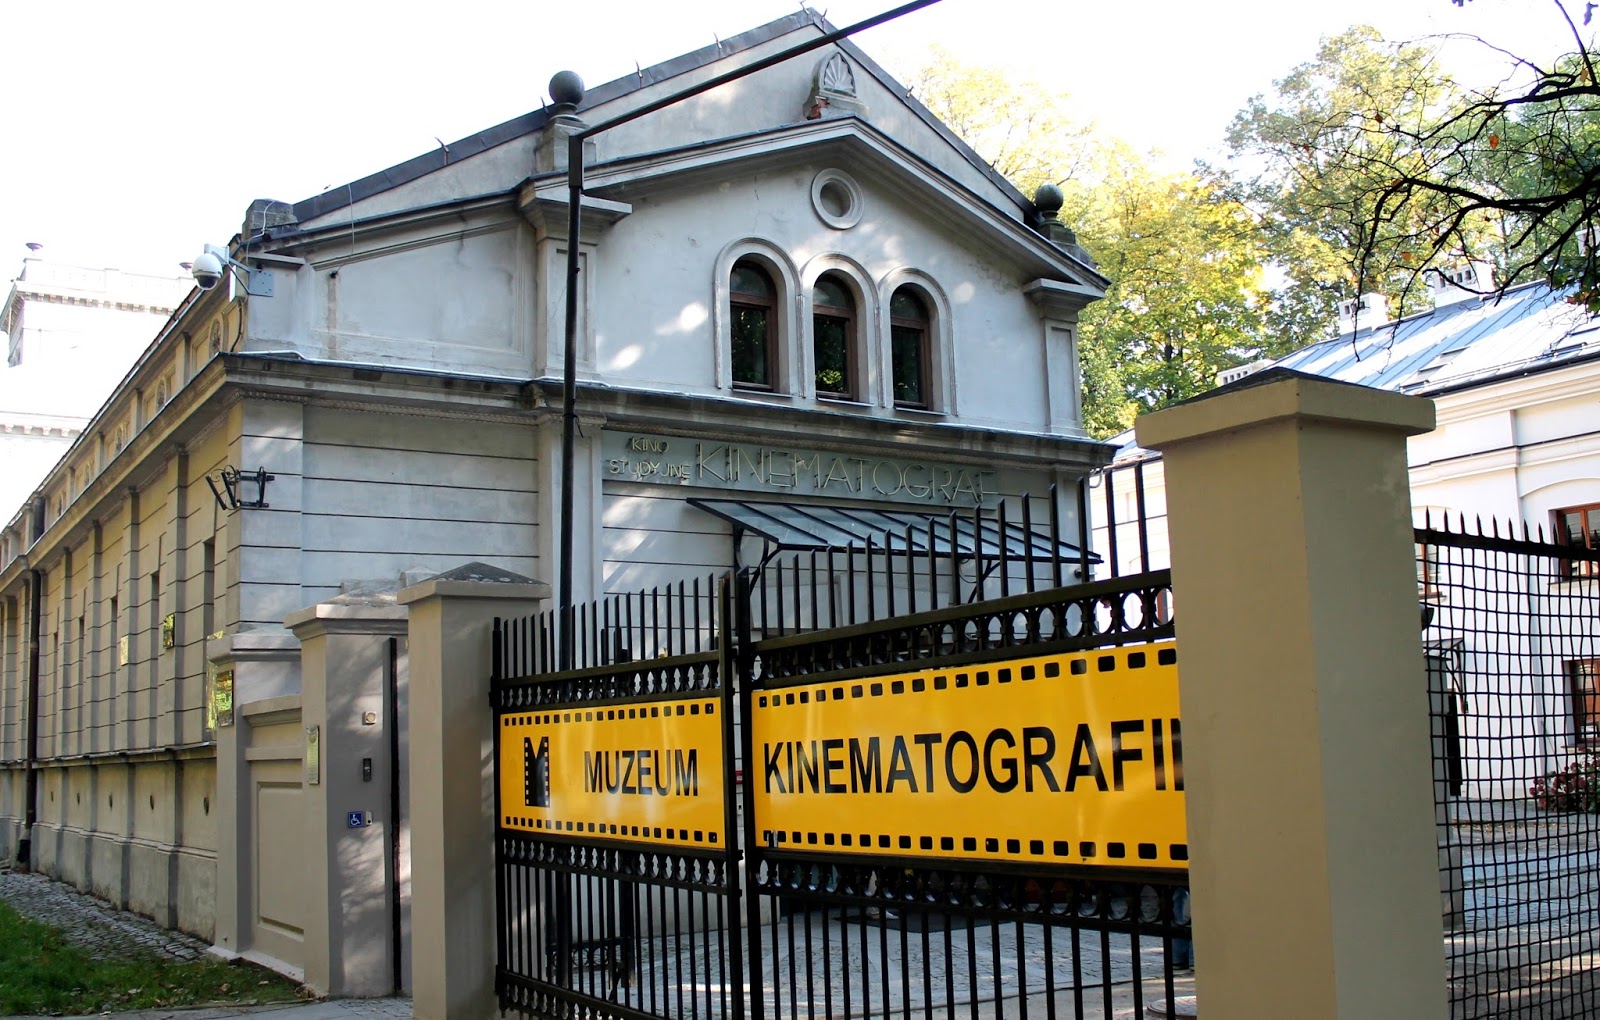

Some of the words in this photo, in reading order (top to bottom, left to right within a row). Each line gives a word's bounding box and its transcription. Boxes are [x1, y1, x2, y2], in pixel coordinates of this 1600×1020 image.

[630, 437, 670, 453] KINO
[609, 459, 691, 479] STUDYJNE
[697, 442, 999, 503] KINEMATOGRAF
[584, 749, 699, 797] MUZEUM
